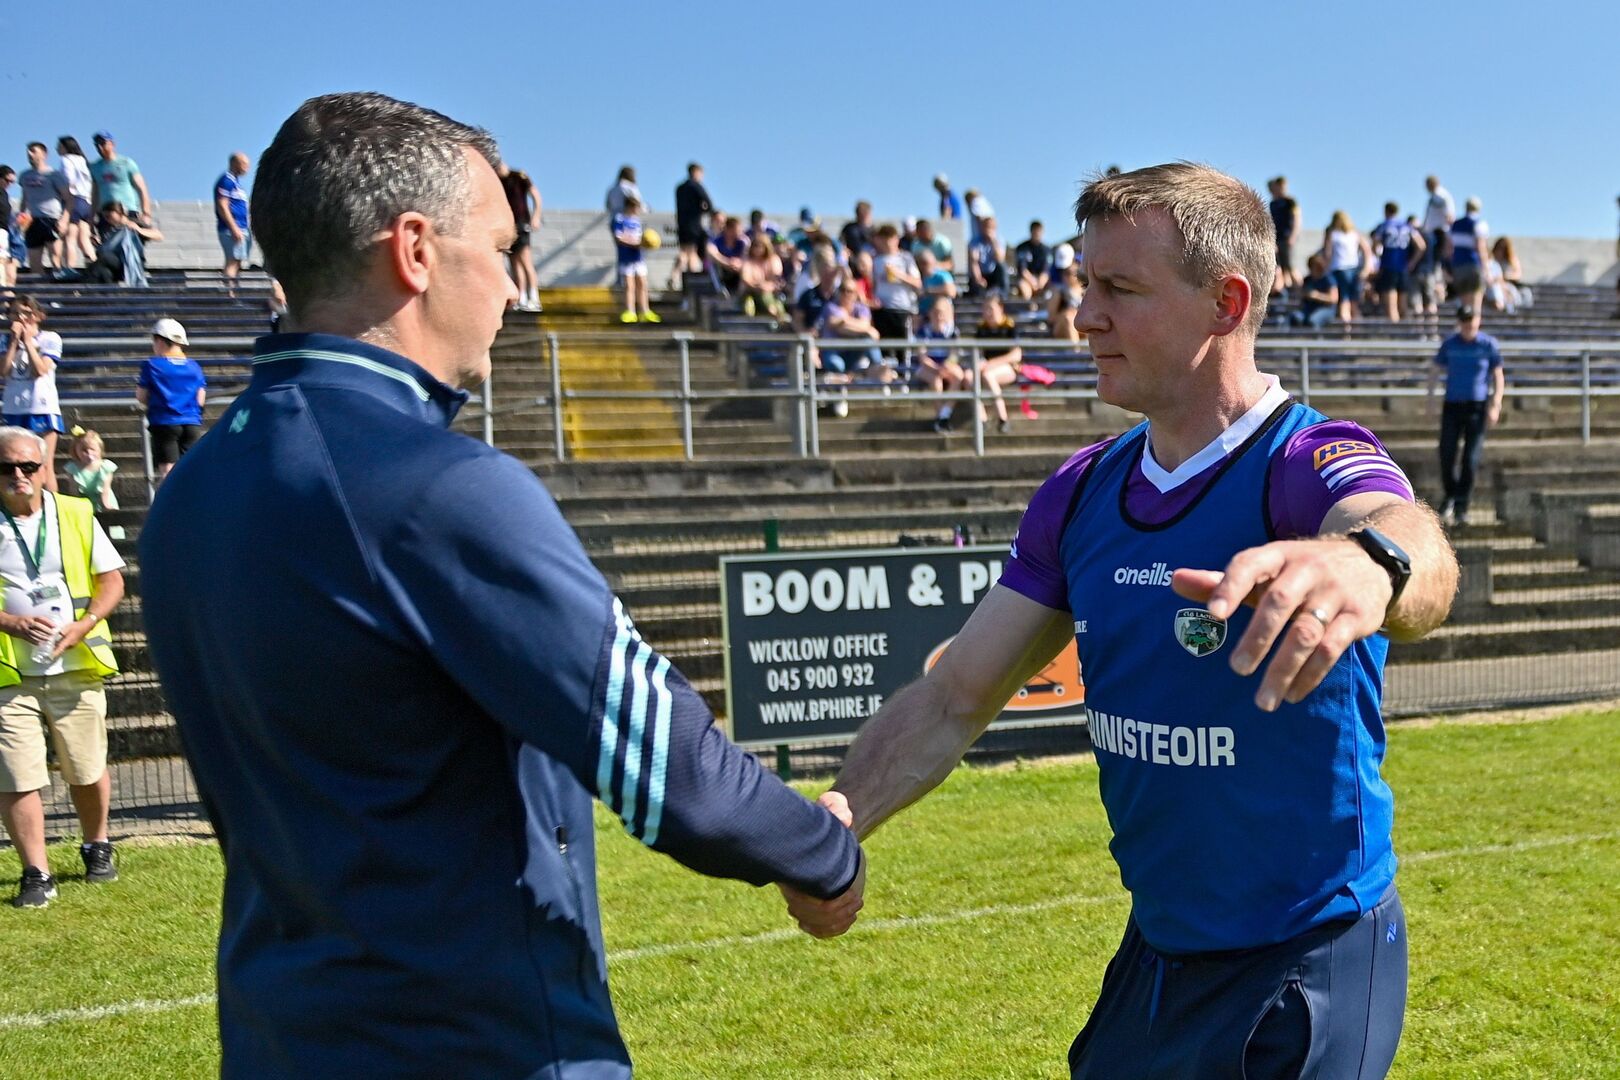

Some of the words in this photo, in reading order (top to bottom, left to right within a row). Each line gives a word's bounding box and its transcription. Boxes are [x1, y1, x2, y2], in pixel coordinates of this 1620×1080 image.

[1319, 442, 1371, 462] HSS
[742, 565, 891, 616] BOOM
[908, 563, 944, 606] &
[748, 636, 829, 664] WICKLOW
[833, 632, 888, 658] OFFICE
[767, 667, 801, 692] 045
[804, 665, 838, 690] 900
[841, 662, 875, 687] 932
[1085, 705, 1235, 767] AINISTEOIR
